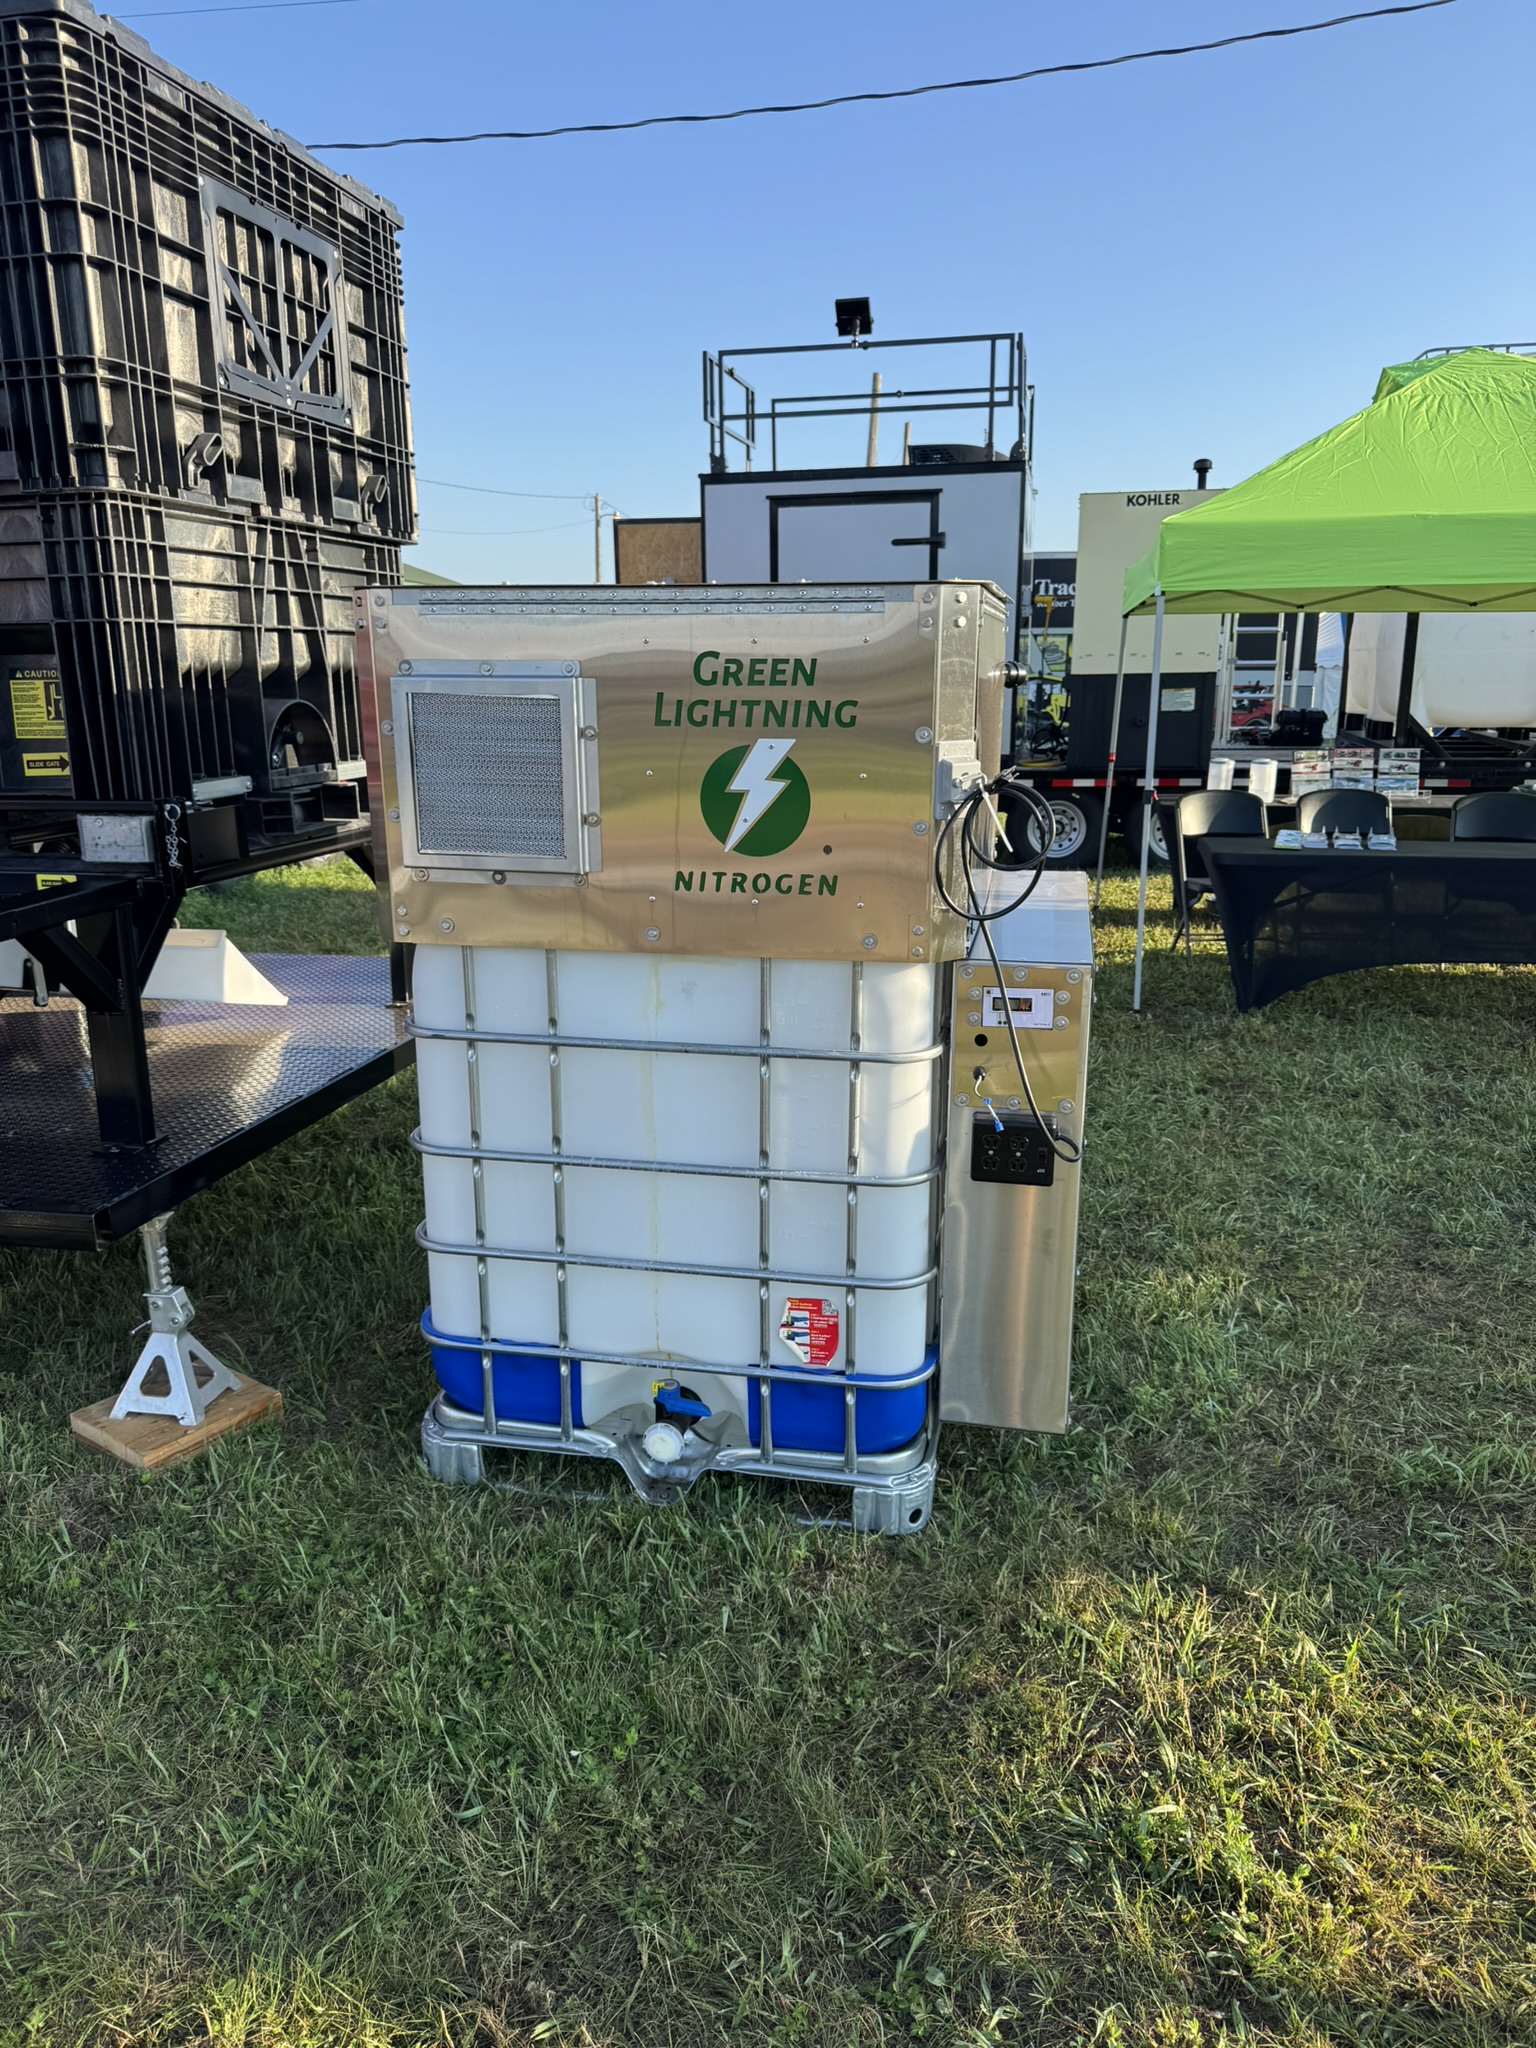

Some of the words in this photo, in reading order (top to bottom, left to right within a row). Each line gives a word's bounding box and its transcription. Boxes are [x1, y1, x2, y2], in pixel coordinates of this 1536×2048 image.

[1126, 493, 1180, 507] KOHLER
[24, 670, 60, 678] CAUTIO
[693, 650, 818, 687] GREEN
[654, 692, 859, 728] LIGHTNING
[675, 871, 838, 896] NITROGEN
